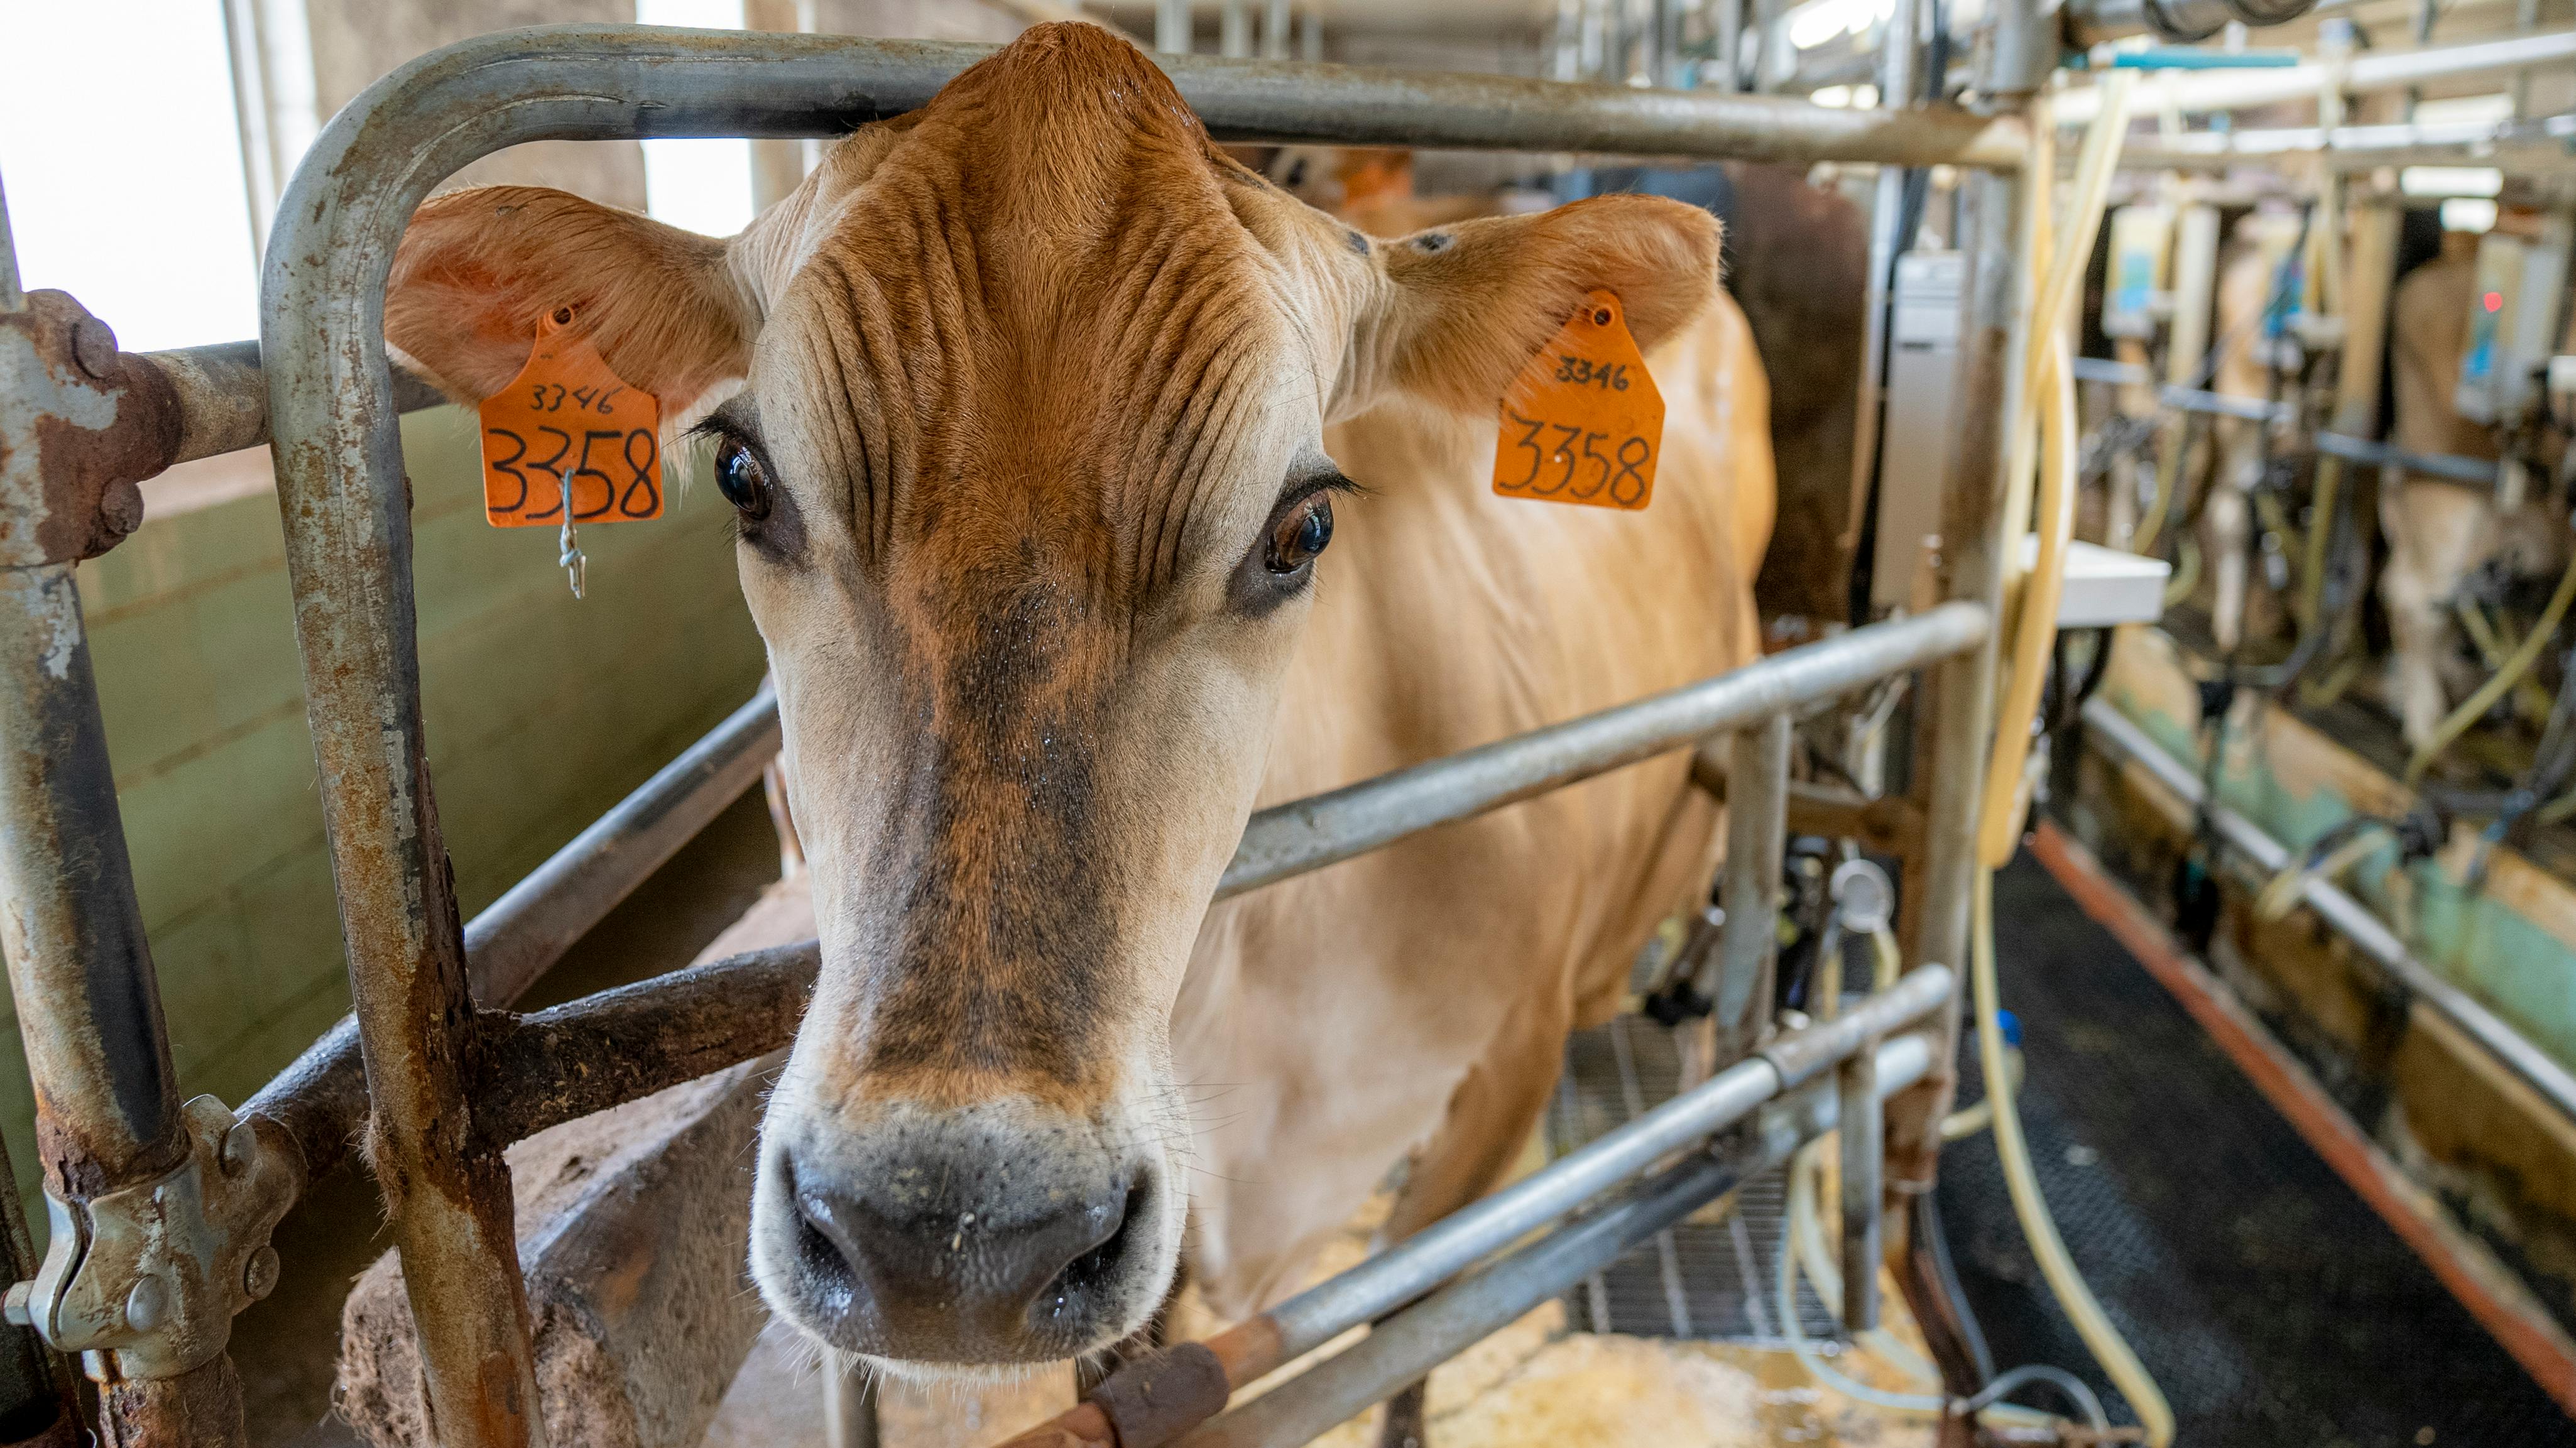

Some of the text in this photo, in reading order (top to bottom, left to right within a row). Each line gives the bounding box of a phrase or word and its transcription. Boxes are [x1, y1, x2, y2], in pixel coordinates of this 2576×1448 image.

[530, 384, 623, 415] 3346
[1555, 355, 1629, 391] 3346
[488, 425, 659, 520] 3358
[1498, 410, 1650, 506] 3358
